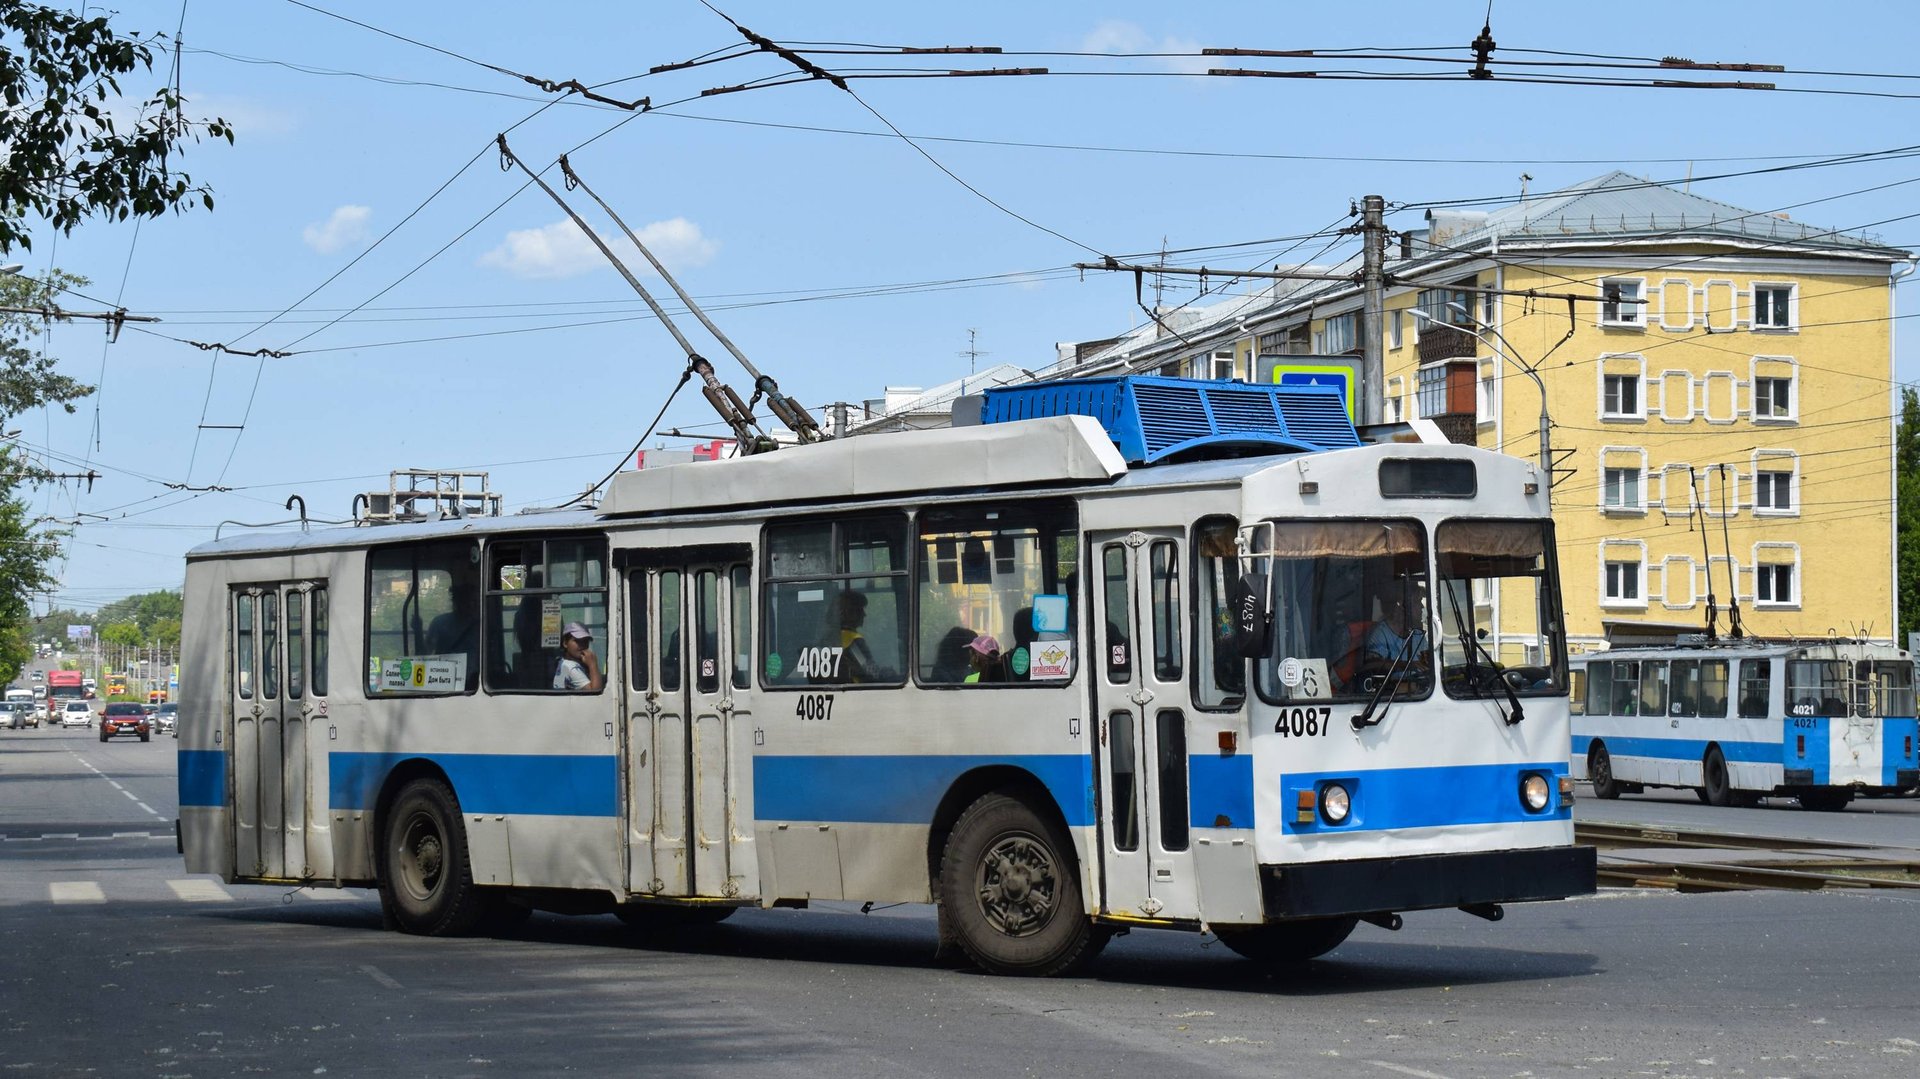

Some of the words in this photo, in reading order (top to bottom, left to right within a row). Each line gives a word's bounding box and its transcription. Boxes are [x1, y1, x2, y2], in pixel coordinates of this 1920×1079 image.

[1242, 594, 1257, 632] 4087
[797, 647, 843, 678] 4087
[416, 667, 422, 683] 6
[428, 675, 438, 684] Дом
[1302, 667, 1319, 698] 6
[796, 694, 834, 720] 4087
[1672, 702, 1681, 713] 4021
[1793, 704, 1814, 715] 4021
[1275, 707, 1331, 738] 4087
[1794, 718, 1817, 728] 4021
